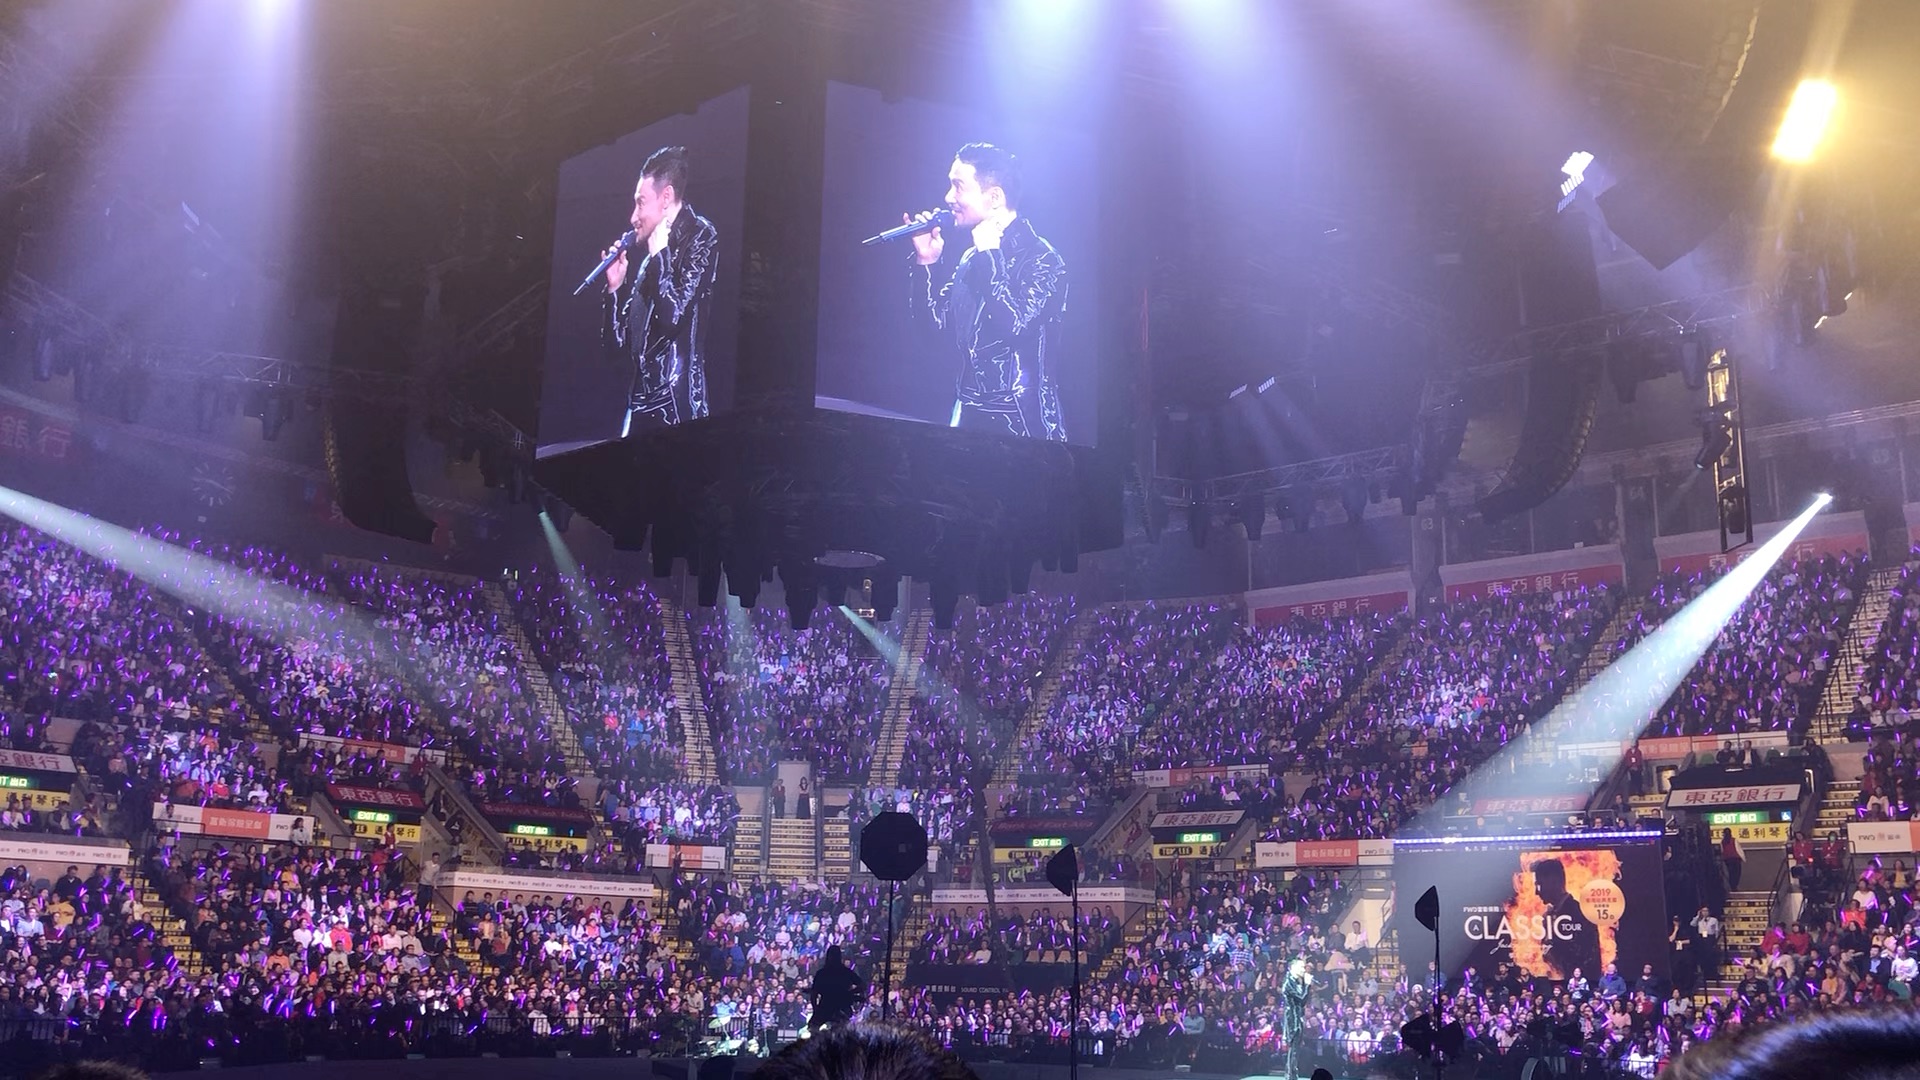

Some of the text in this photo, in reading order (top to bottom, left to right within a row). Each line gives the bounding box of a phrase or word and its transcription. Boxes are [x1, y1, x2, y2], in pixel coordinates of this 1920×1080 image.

[1486, 572, 1579, 598] 東亞銀行
[9, 777, 28, 787] 出口
[337, 787, 414, 806] 東亞銀行
[1683, 786, 1786, 804] 東亞銀行
[357, 810, 376, 820] EXIT
[1161, 812, 1234, 826] 東亞銀行
[1713, 813, 1757, 823] EXIT 出口
[517, 825, 535, 833] EXIT
[1032, 838, 1049, 847] EXIT
[1182, 833, 1200, 842] EXIT
[1590, 888, 1611, 897] 2019
[1464, 914, 1582, 940] A CLASSIC TOUR
